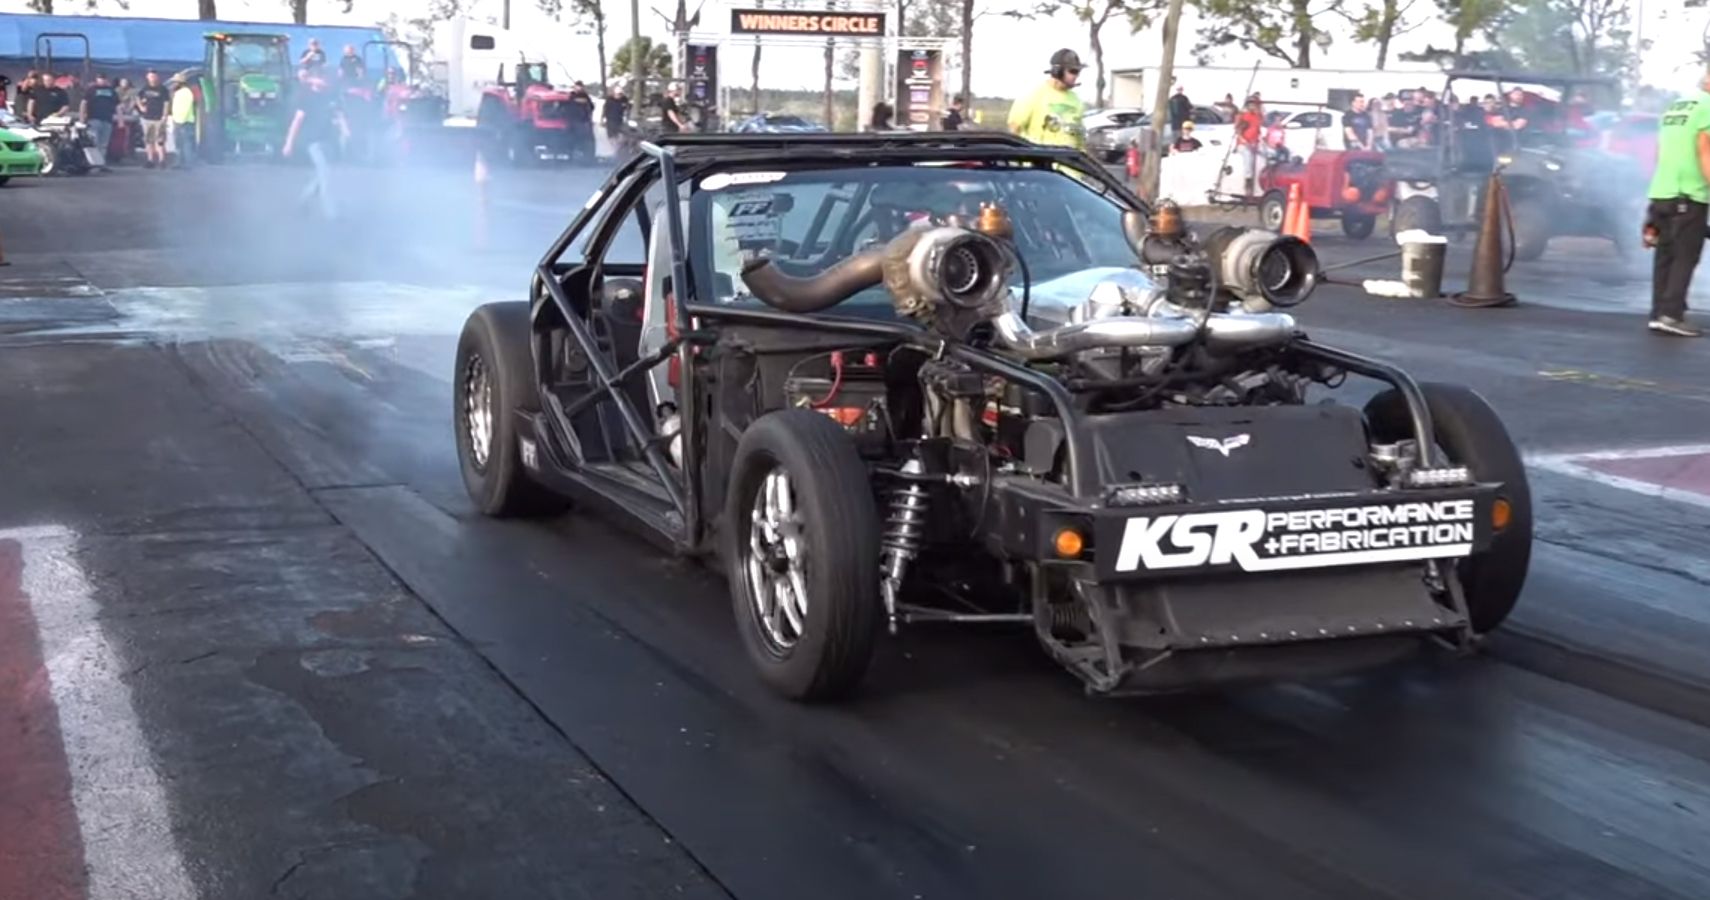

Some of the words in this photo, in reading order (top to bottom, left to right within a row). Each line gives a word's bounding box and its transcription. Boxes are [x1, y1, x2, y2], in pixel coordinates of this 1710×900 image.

[739, 14, 819, 31] WINNERS
[820, 16, 878, 32] CIRCLE
[1266, 500, 1474, 532] PERFORMANCE
[1115, 509, 1267, 571] KSR
[1264, 522, 1474, 555] +FABRICATION
